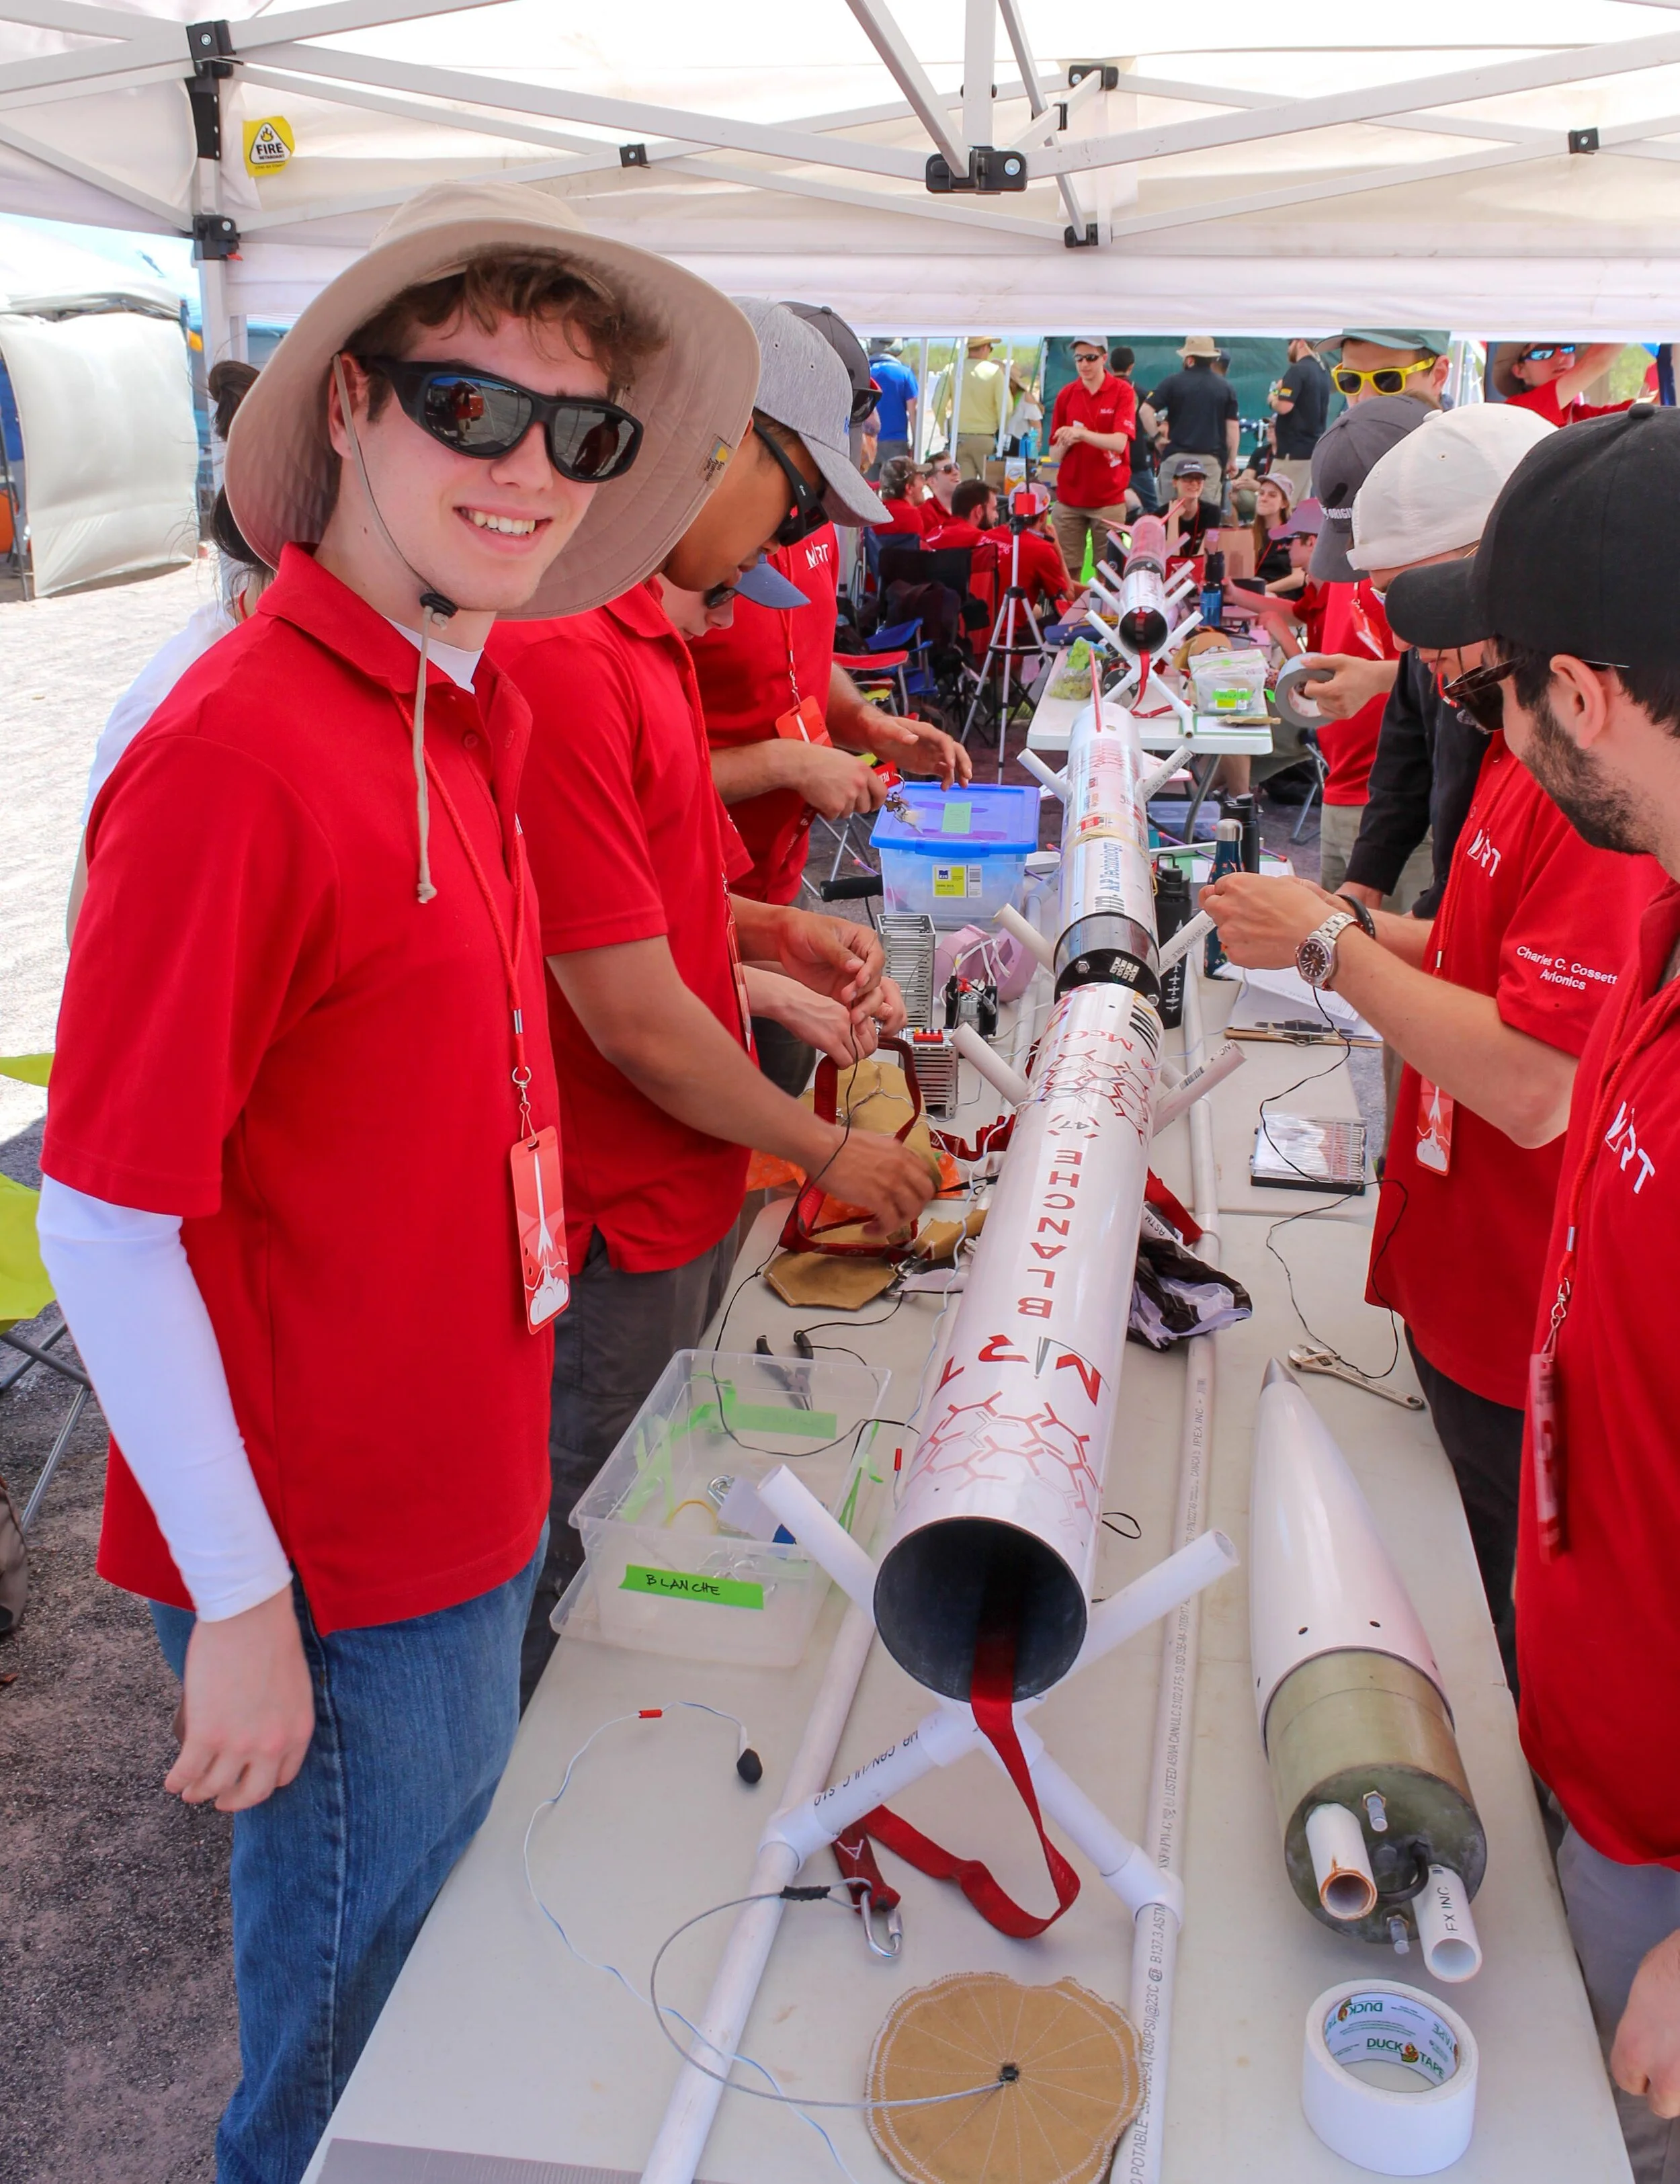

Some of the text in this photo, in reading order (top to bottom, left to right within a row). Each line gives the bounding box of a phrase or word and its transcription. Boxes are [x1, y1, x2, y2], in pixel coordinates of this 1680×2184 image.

[256, 143, 284, 155] FIRE
[1100, 842, 1123, 878] Technology
[1171, 935, 1196, 958] POTABLE
[1517, 946, 1552, 966] Charles
[1540, 968, 1587, 990] Avionics
[1017, 1149, 1083, 1319] BLANCHE
[1144, 1214, 1167, 1236] ASTM
[1193, 1408, 1204, 1423] INC
[1191, 1425, 1203, 1447] IPEX
[646, 1574, 720, 1595] BLANCHE
[1167, 1767, 1177, 1796] LISTED
[1437, 1886, 1453, 1909] INC
[1349, 2002, 1384, 2015] DUCK
[1366, 2038, 1404, 2052] DUCK
[1419, 2052, 1445, 2077] TAPE
[1130, 2119, 1148, 2176] POTABLE
